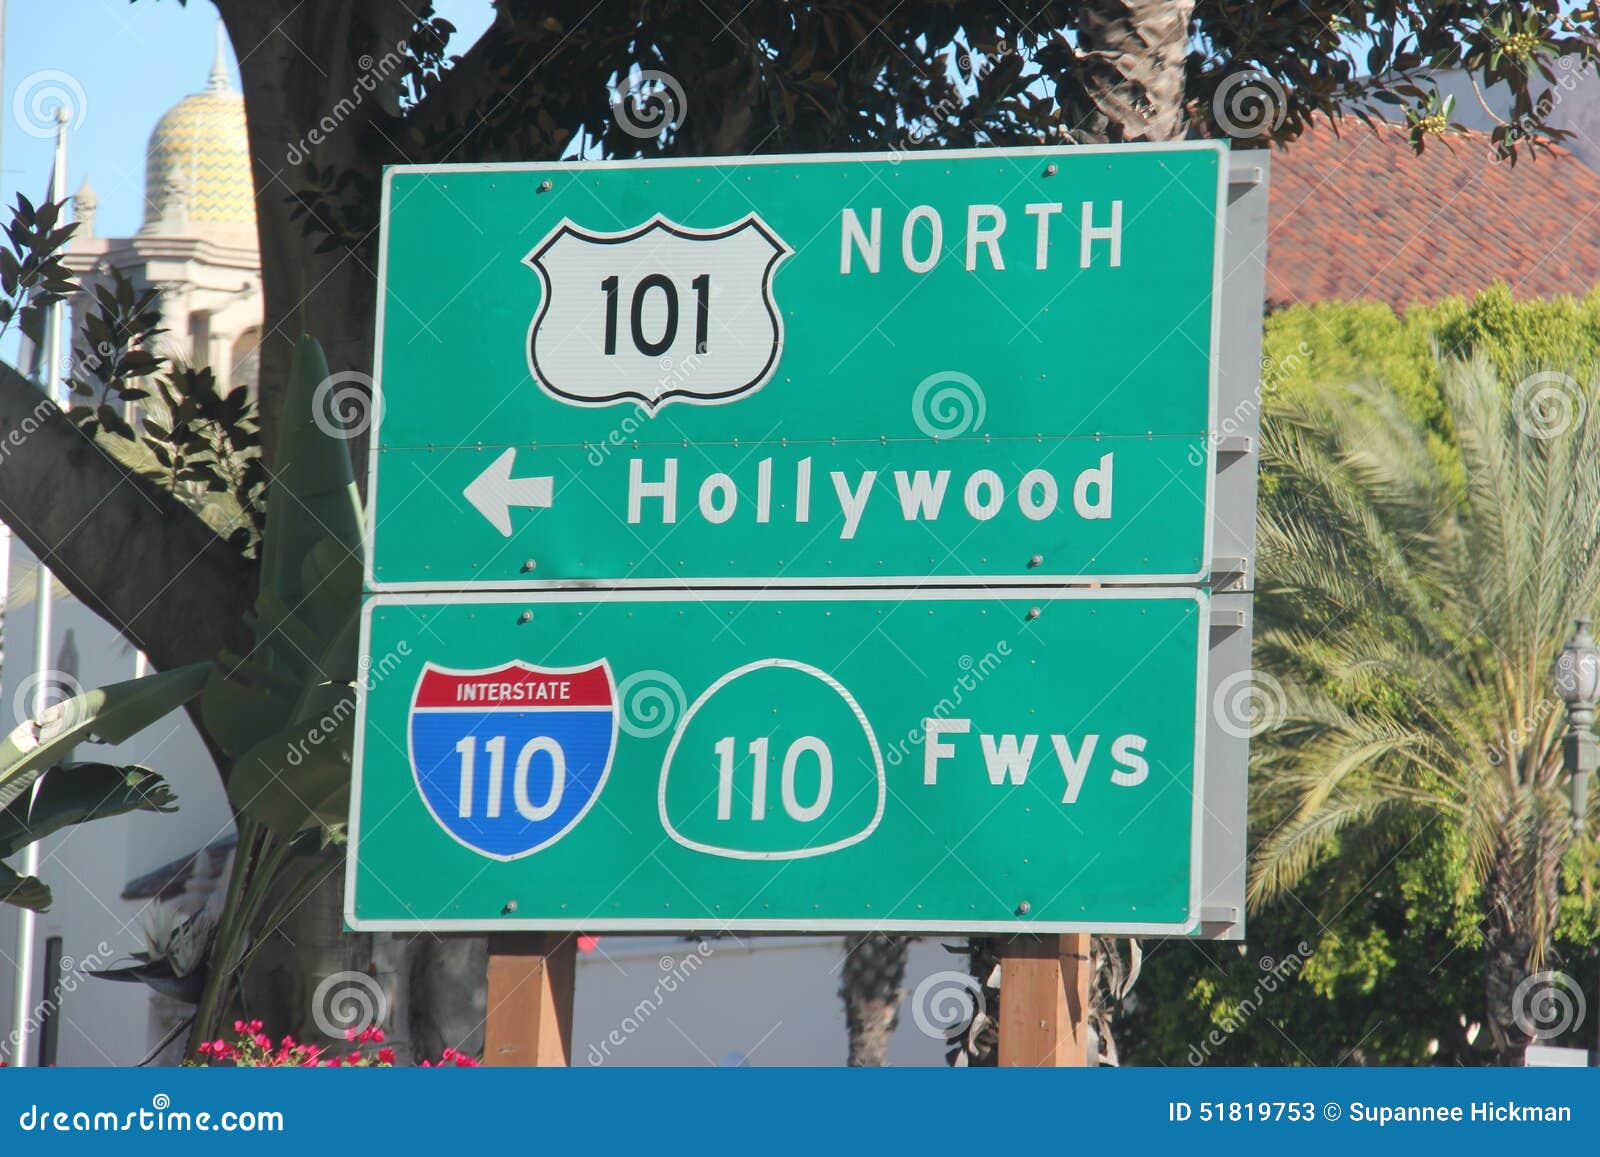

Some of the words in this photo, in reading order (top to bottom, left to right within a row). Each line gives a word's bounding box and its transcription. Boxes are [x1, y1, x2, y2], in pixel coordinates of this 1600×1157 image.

[839, 200, 1124, 275] NORTH
[600, 273, 711, 357] 101
[627, 452, 1114, 540] Hollywood
[456, 681, 571, 702] INTERSTATE
[456, 735, 566, 822] 110
[713, 735, 834, 822] 110
[923, 718, 1150, 804] Fwys
